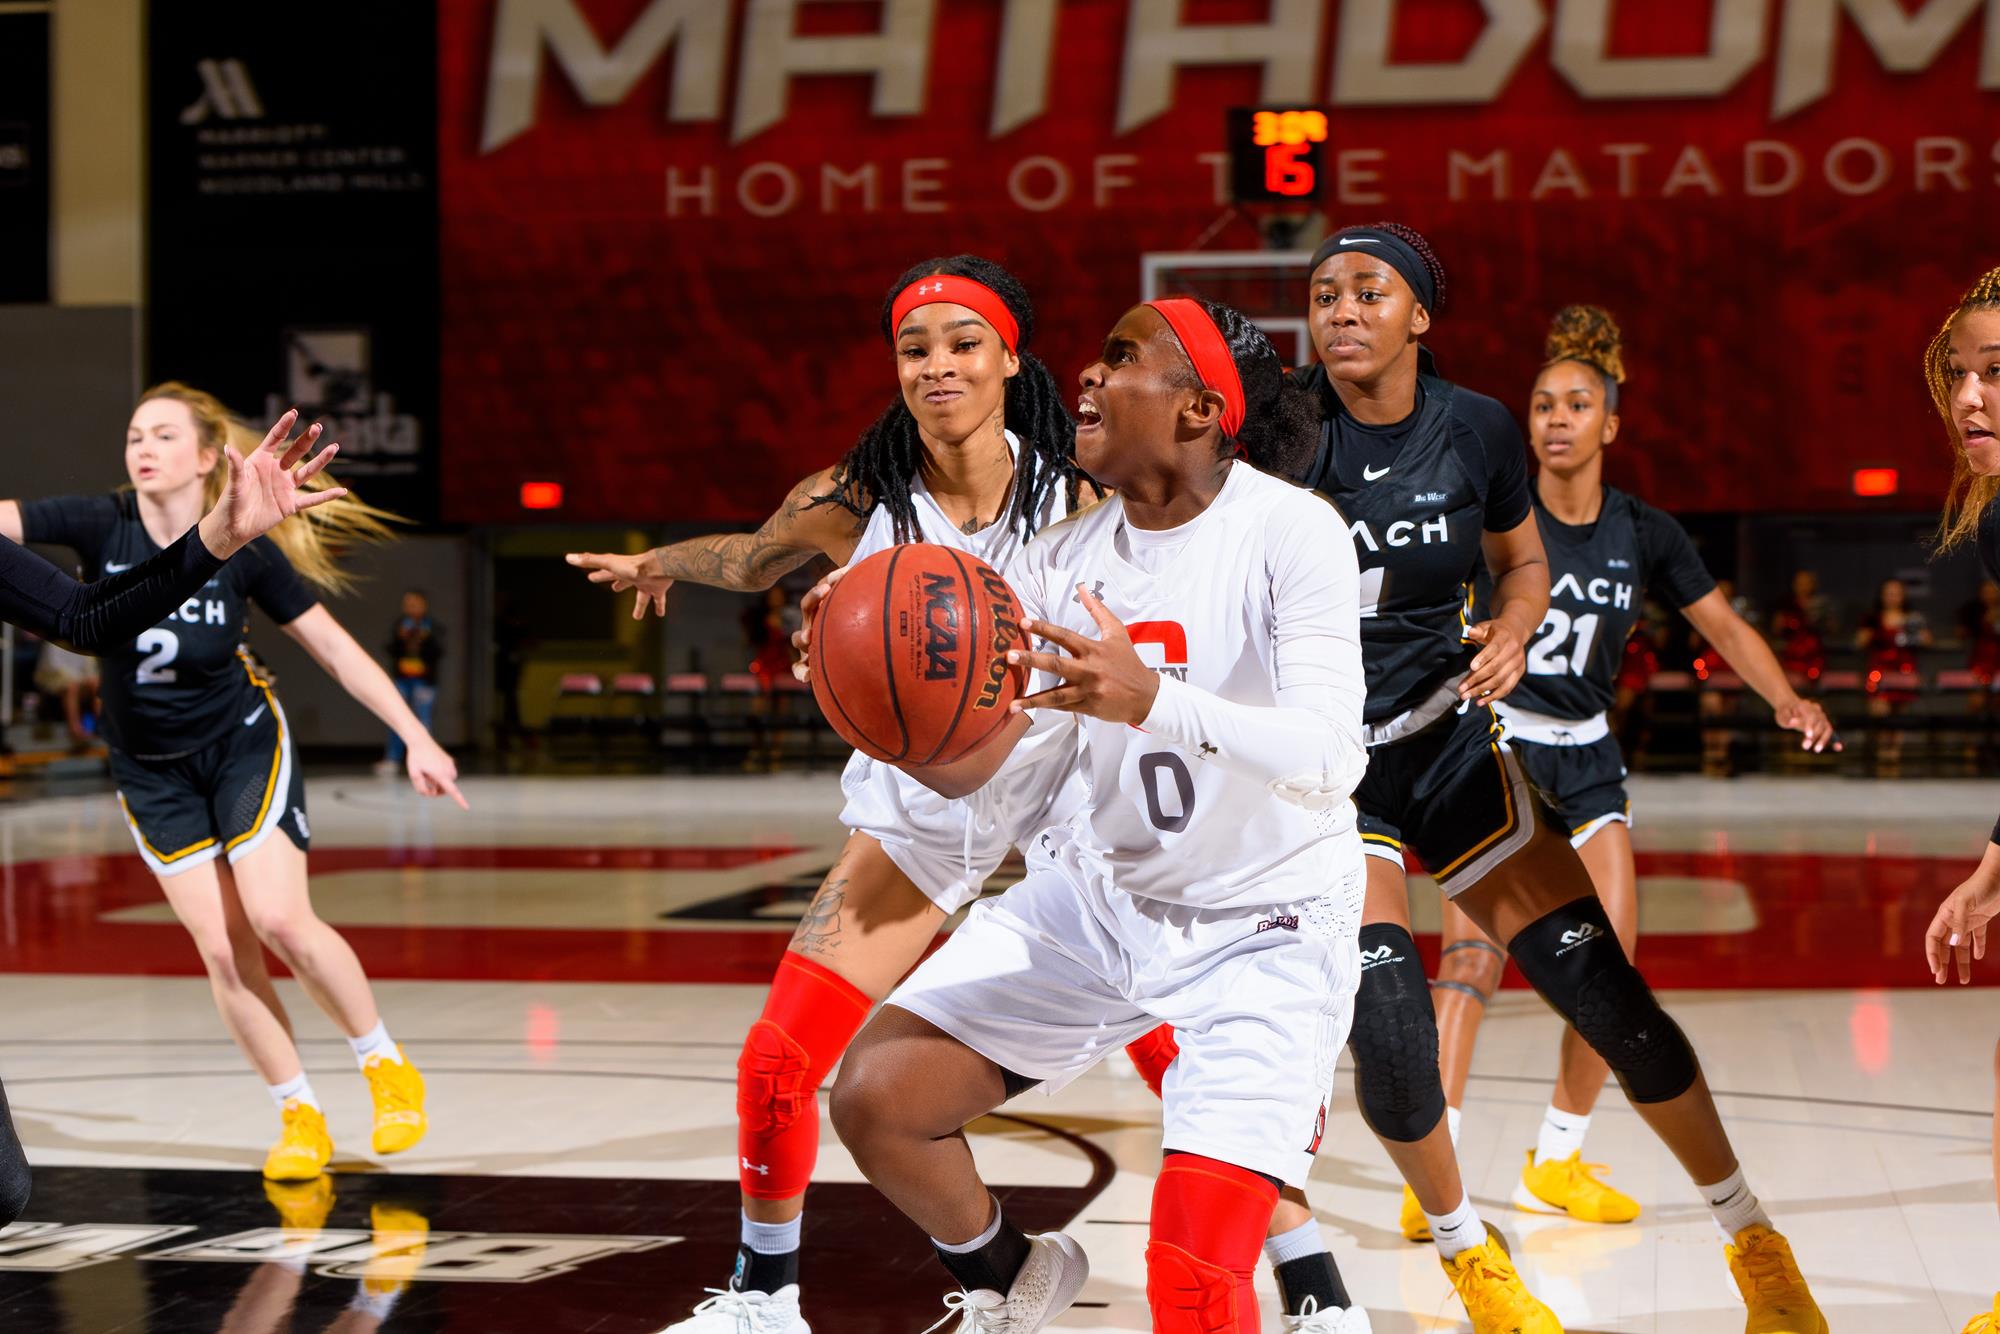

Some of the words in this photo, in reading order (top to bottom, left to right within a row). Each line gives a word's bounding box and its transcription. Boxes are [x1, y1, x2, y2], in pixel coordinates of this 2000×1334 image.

[667, 160, 947, 217] HOME
[1009, 155, 1137, 212] OF
[1197, 149, 1386, 205] TE
[1449, 138, 2000, 199] MATADOR
[1350, 513, 1449, 551] ACH
[923, 571, 958, 681] NCAA
[1549, 573, 1632, 610] ACH
[136, 628, 179, 685] 2
[974, 565, 1019, 709] Wilson
[1527, 608, 1598, 677] 21
[1139, 752, 1195, 833] 0
